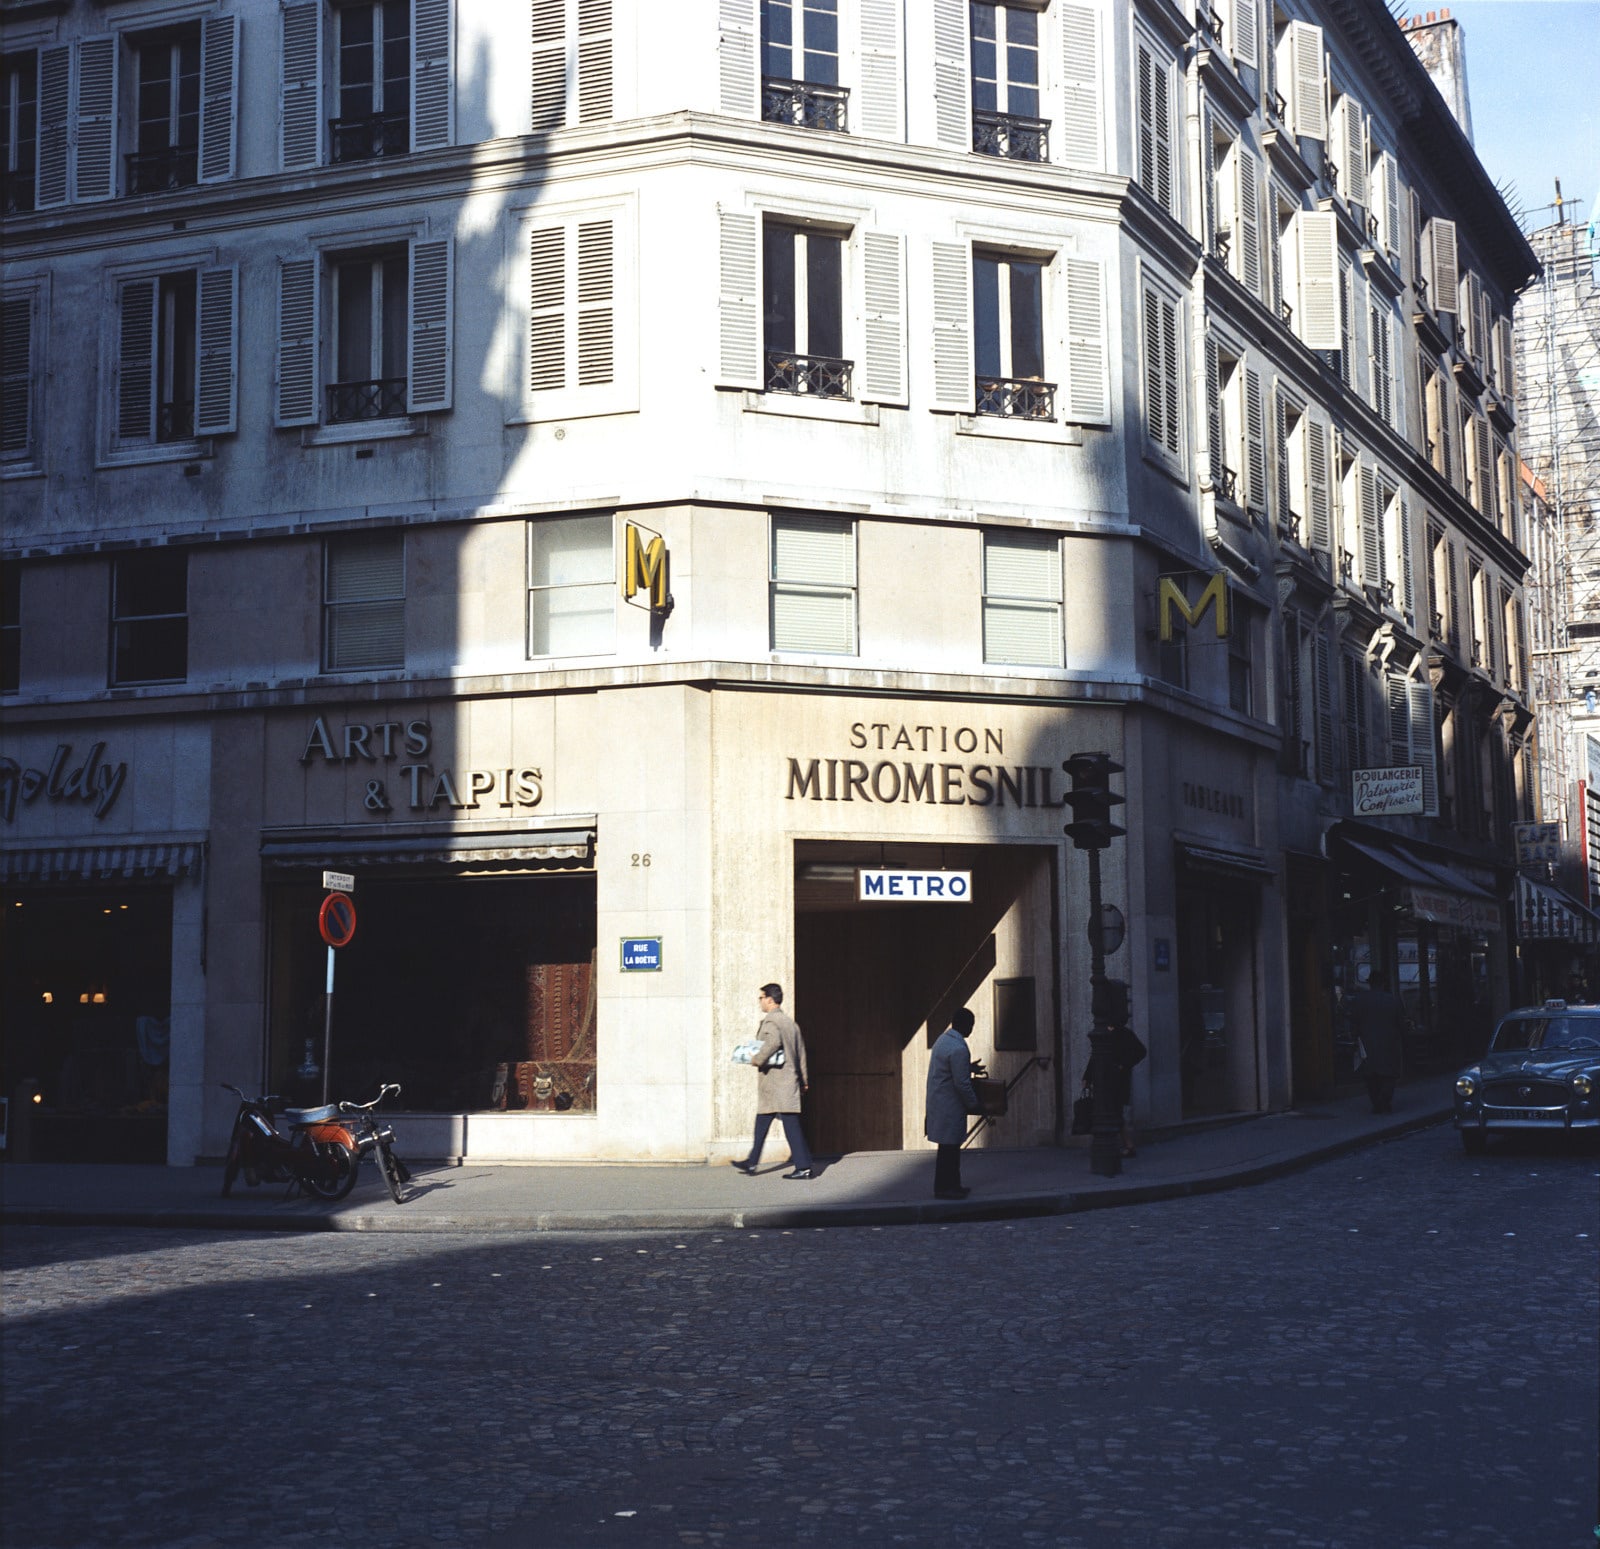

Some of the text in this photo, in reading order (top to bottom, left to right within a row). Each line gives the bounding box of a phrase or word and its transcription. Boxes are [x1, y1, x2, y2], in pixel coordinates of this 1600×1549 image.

[625, 522, 666, 608] M
[1160, 571, 1228, 641] M
[299, 716, 432, 762] ARTS
[850, 722, 1004, 755] STATION
[363, 764, 543, 814] & TAPIS
[784, 757, 1065, 809] MIROMESNIL
[1354, 768, 1421, 782] BOULANGERIE
[631, 853, 652, 867] 26
[865, 875, 967, 896] METRO
[625, 956, 634, 965] LA
[633, 943, 649, 953] RUE
